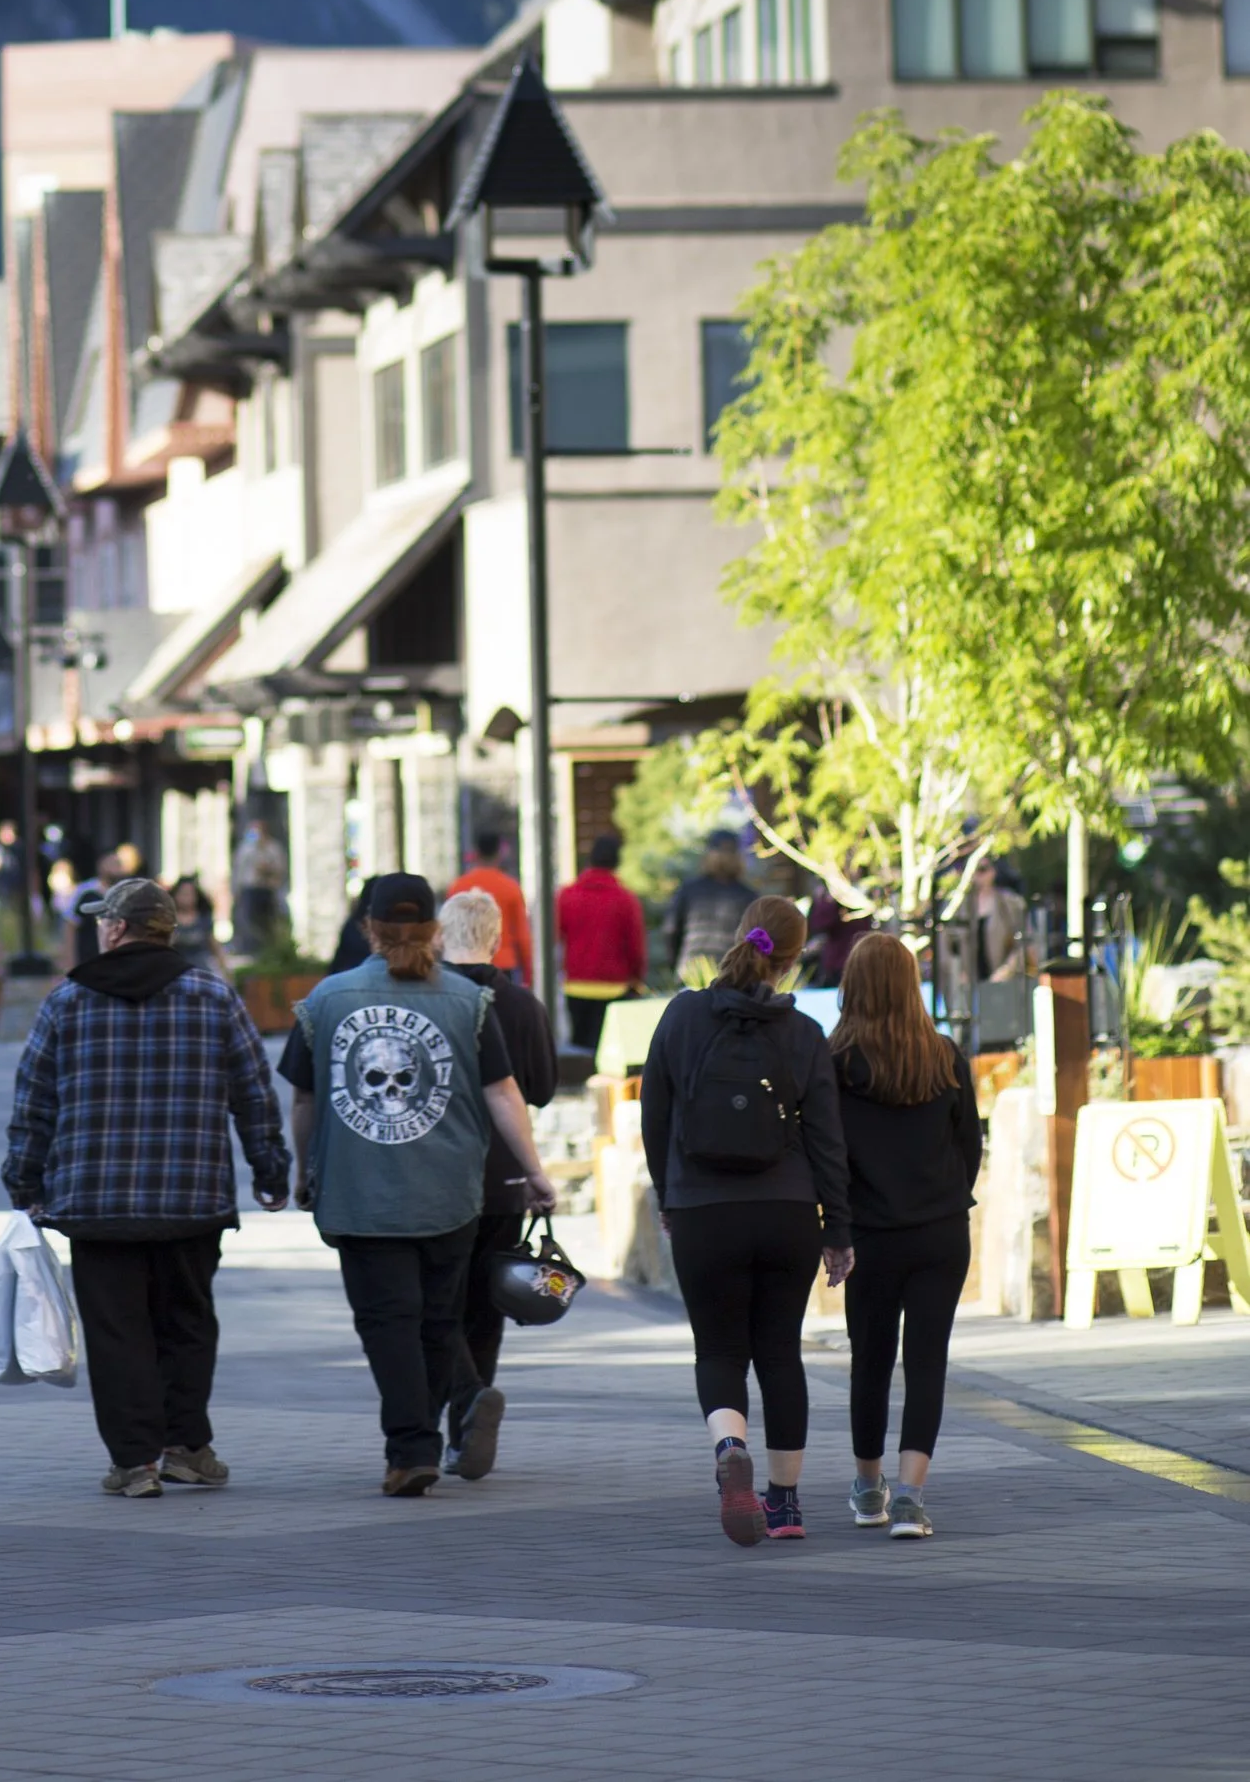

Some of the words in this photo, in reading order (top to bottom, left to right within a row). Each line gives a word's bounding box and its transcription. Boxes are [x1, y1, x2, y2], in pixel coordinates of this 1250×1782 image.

[335, 1008, 444, 1050] STURGIS
[333, 1094, 375, 1134] BLACK
[377, 1123, 420, 1140] HILLS
[417, 1086, 449, 1128] RALLY
